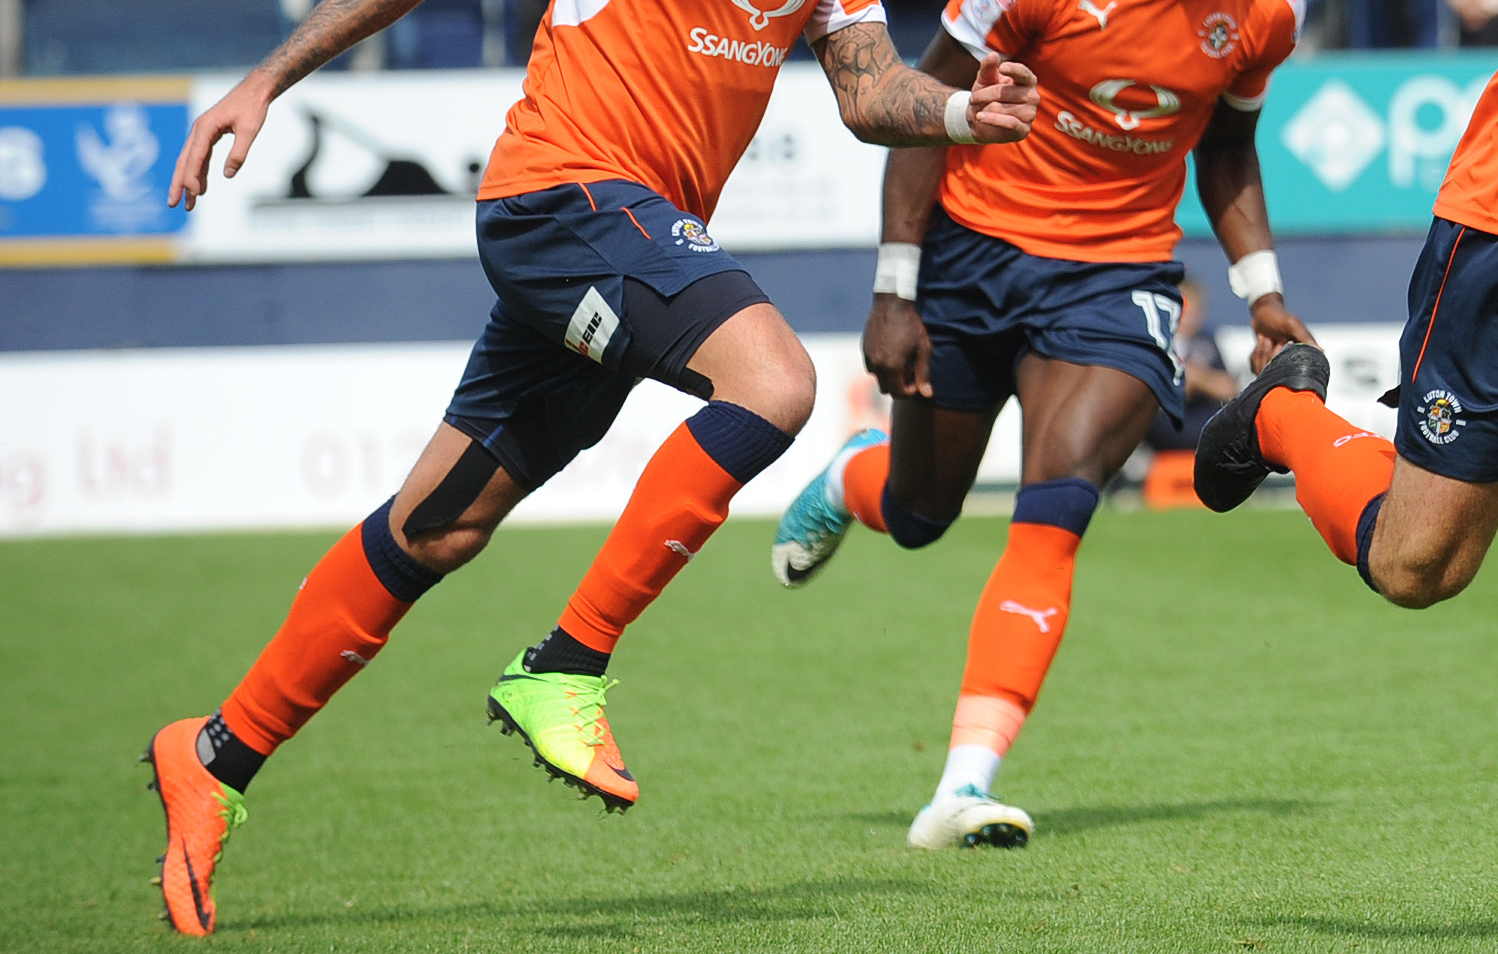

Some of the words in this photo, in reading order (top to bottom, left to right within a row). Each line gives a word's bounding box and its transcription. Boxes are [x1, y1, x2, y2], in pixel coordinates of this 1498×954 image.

[1054, 110, 1176, 155] SSANGYONG
[1422, 389, 1446, 404] LUTON
[1445, 391, 1463, 414] TOWN
[1418, 419, 1445, 445] FOOTBALL
